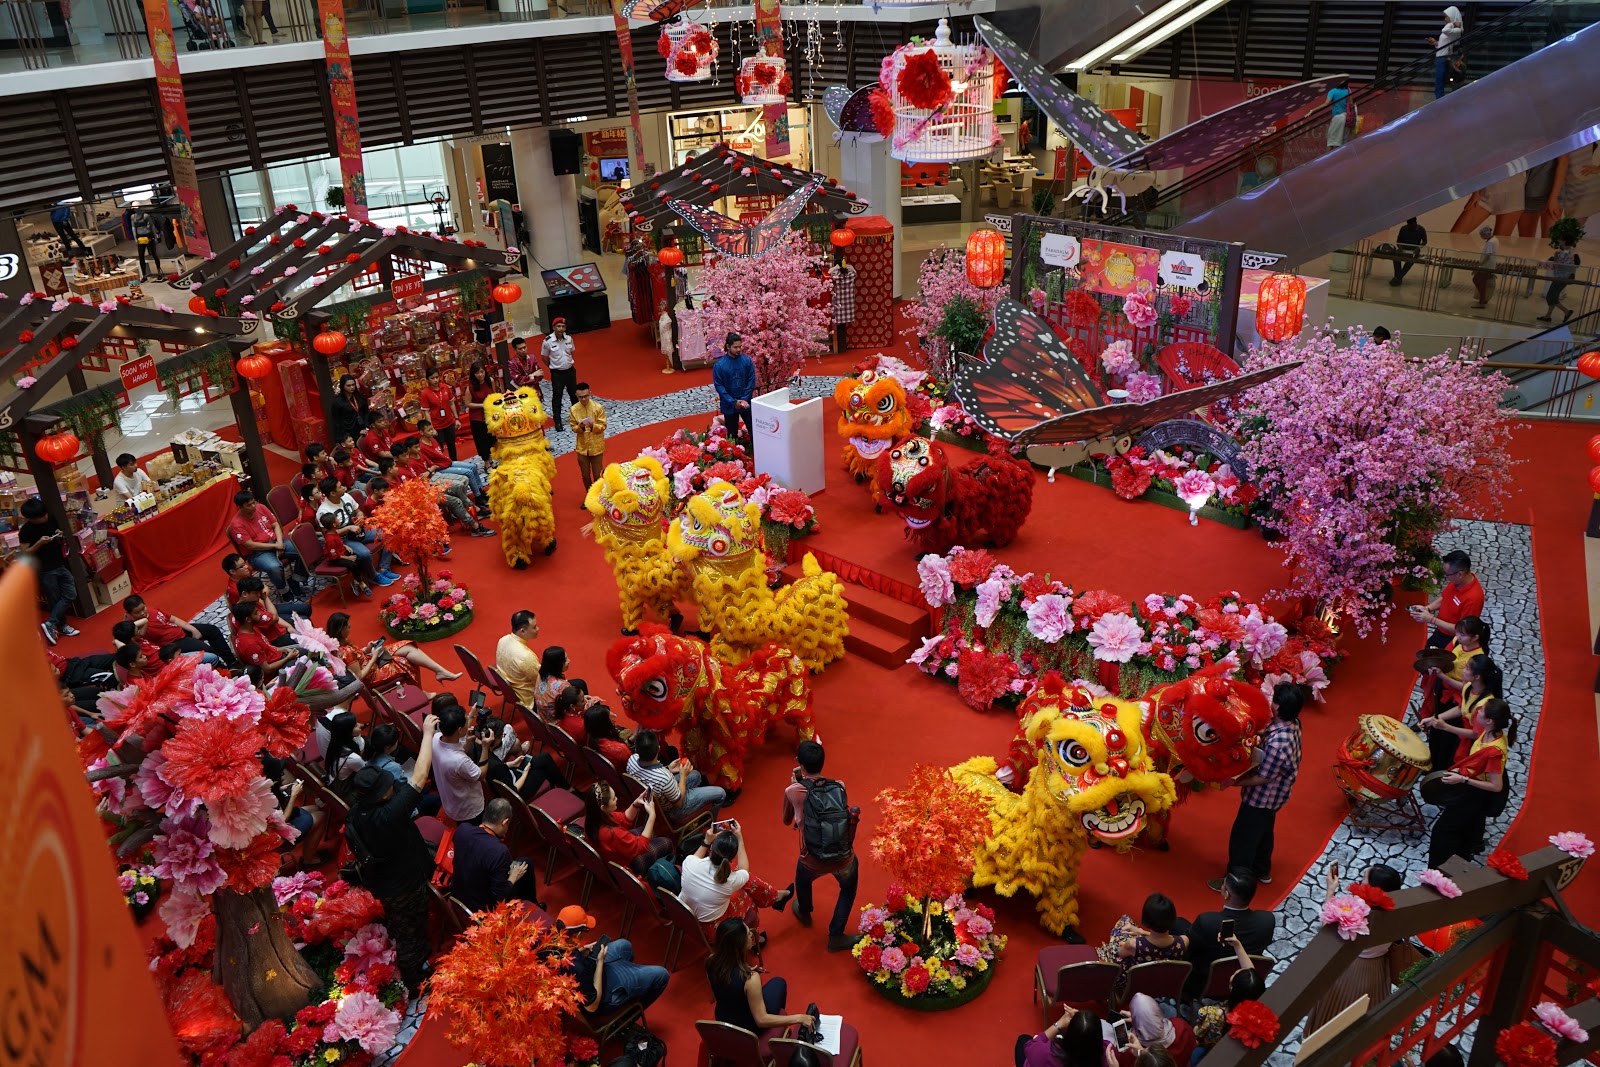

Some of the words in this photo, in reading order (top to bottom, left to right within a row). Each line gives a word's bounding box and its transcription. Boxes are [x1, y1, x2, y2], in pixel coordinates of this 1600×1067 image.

[1171, 263, 1194, 273] WCT
[394, 285, 404, 294] JIN
[405, 282, 413, 292] YE
[414, 280, 421, 289] YE
[121, 365, 138, 378] SOON
[139, 359, 154, 371] THYE
[132, 372, 148, 384] HANG
